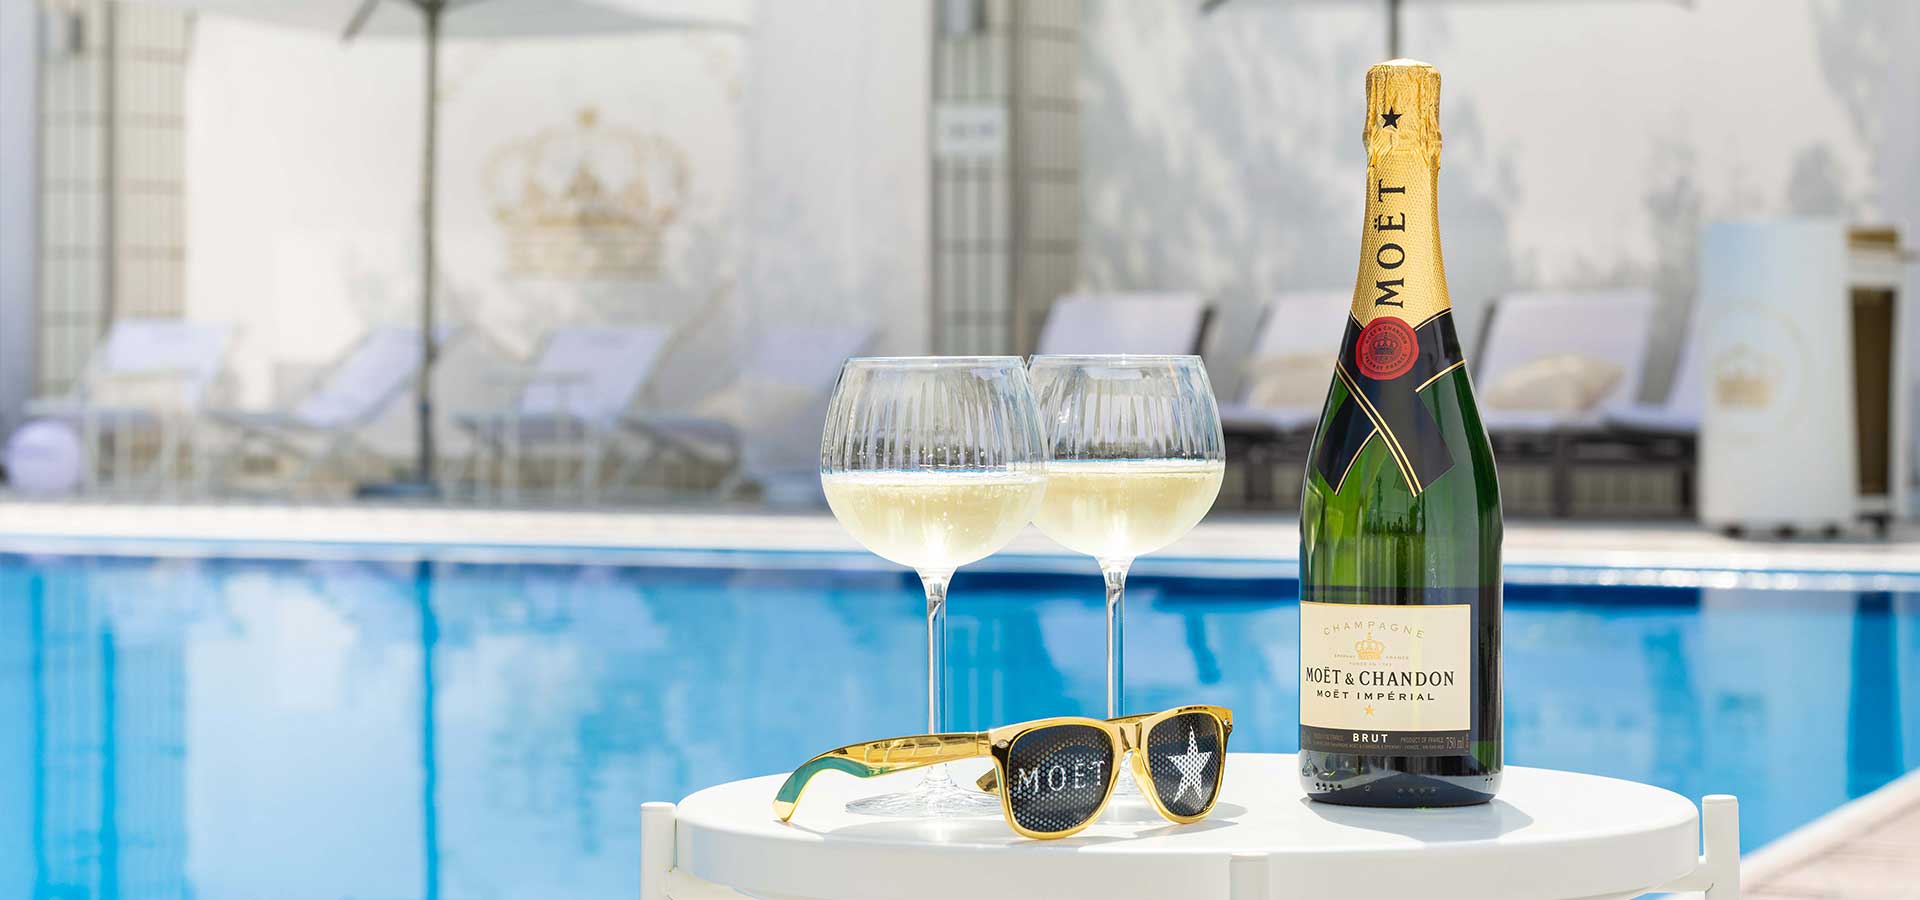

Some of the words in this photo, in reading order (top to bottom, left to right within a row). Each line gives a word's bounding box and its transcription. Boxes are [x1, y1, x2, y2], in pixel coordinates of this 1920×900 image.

[1374, 178, 1406, 308] MOËT
[1323, 621, 1425, 639] CHAMPAGNE
[1305, 666, 1342, 685] MOËT
[1345, 672, 1355, 686] &
[1359, 670, 1455, 687] CHANDON
[1316, 689, 1349, 700] MOËT
[1357, 691, 1435, 702] IMPÉRIAL
[1352, 732, 1389, 744] BRUT
[1017, 758, 1106, 795] MOËT
